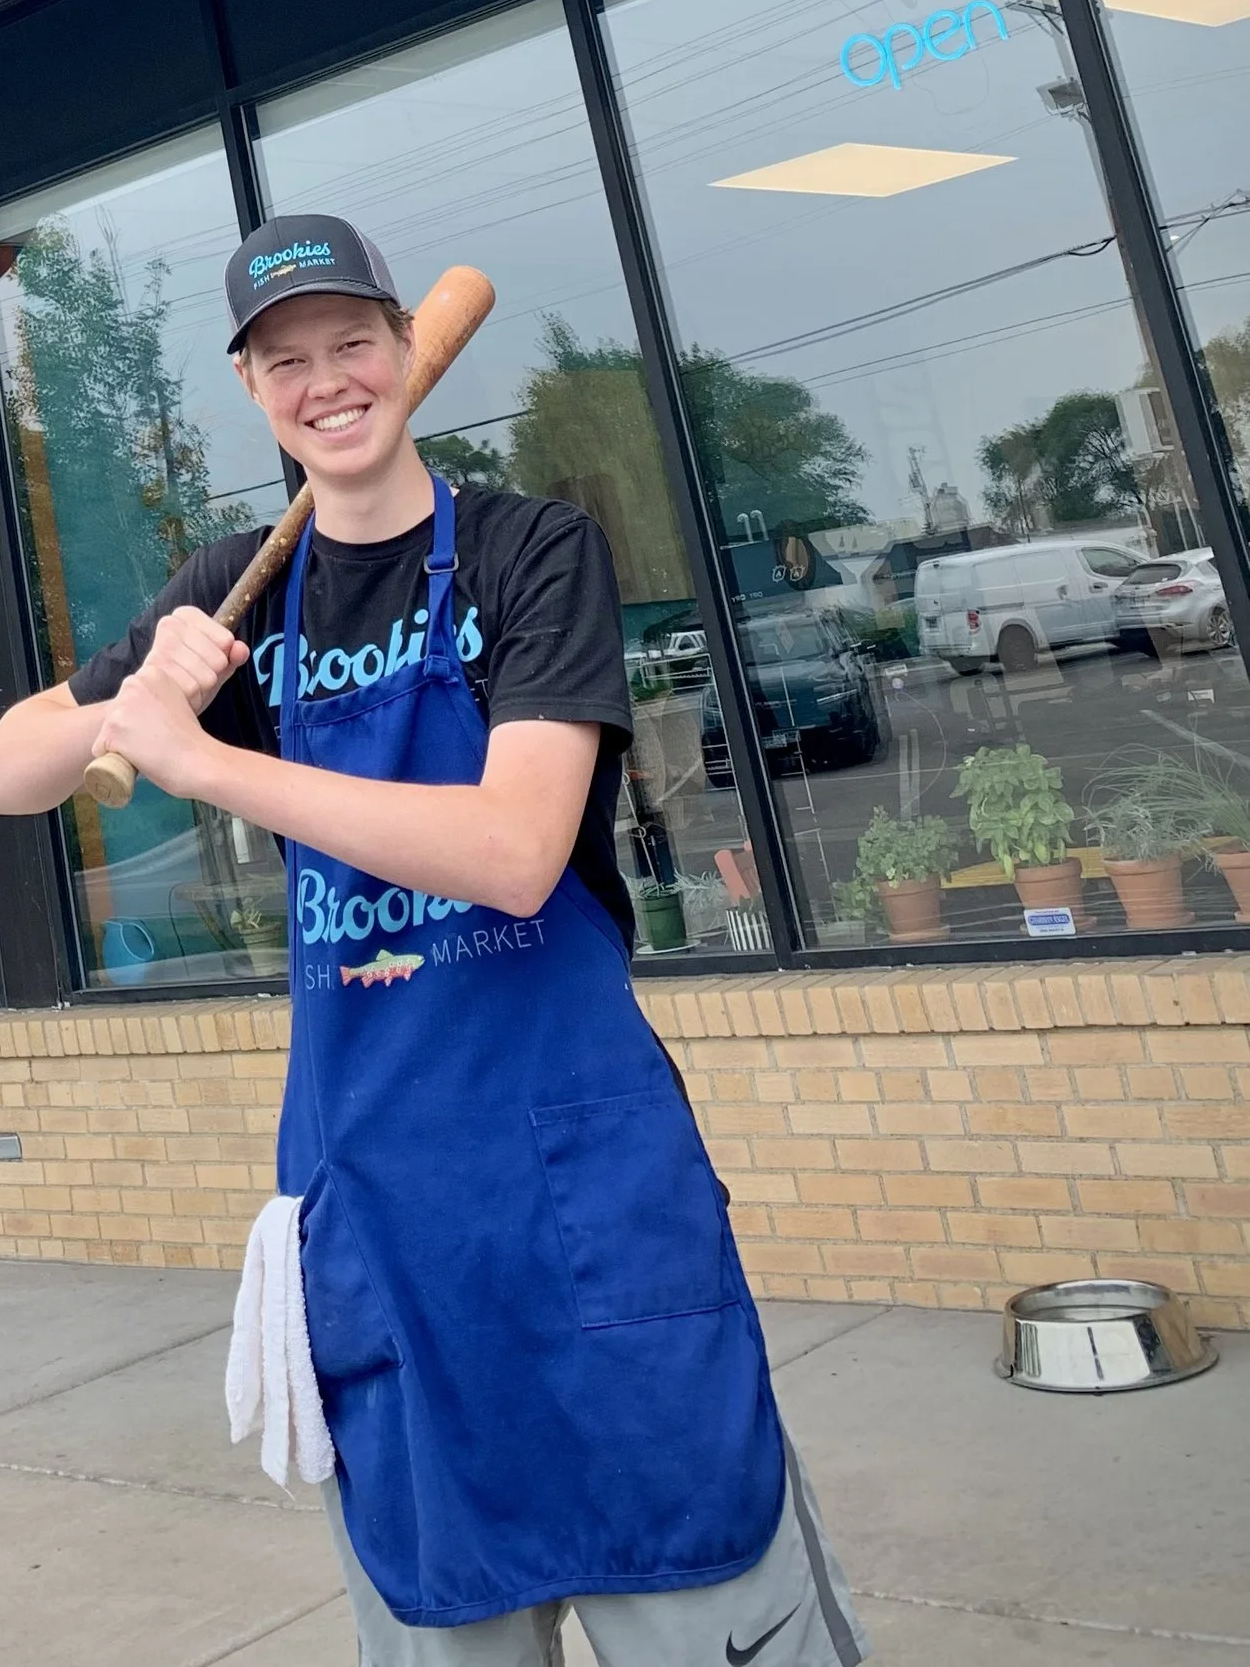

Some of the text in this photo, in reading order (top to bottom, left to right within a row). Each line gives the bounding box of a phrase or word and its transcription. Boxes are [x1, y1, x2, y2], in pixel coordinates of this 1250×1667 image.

[840, 0, 1009, 90] open
[249, 240, 331, 278] Brookies
[253, 258, 336, 290] FISH MARKET
[431, 919, 546, 967] MARKET
